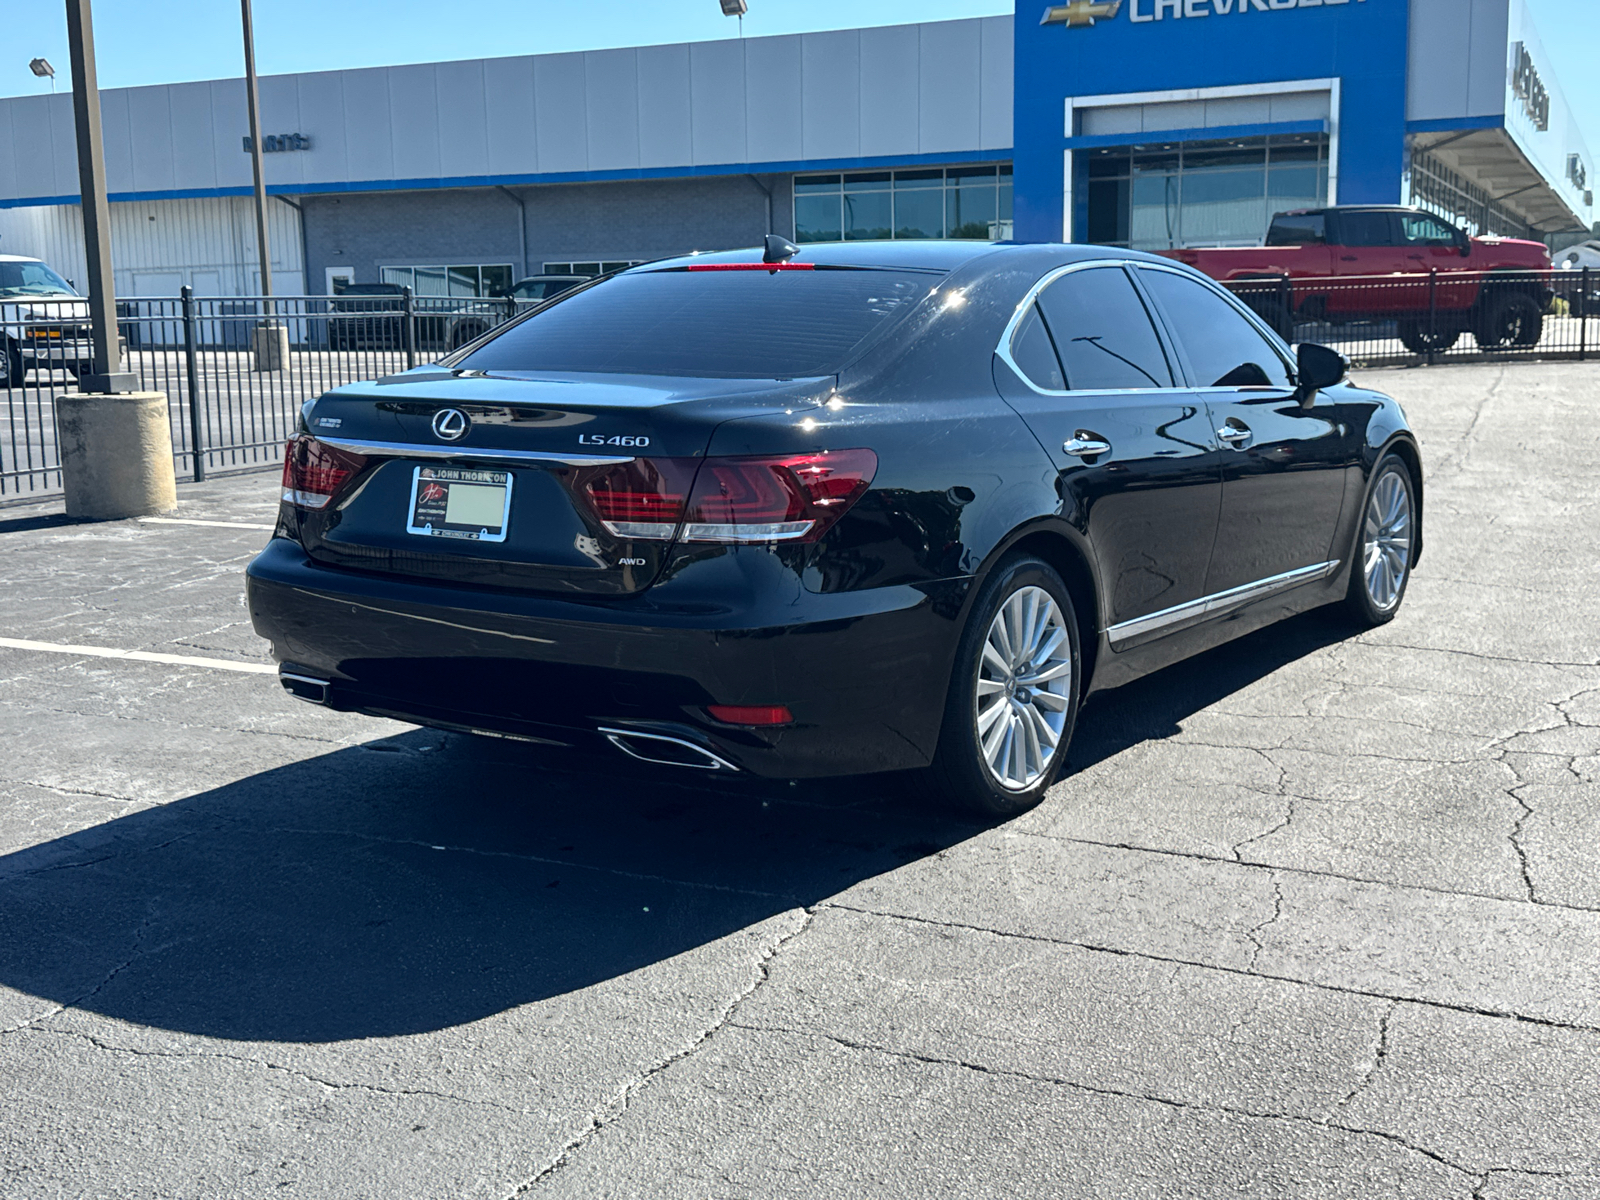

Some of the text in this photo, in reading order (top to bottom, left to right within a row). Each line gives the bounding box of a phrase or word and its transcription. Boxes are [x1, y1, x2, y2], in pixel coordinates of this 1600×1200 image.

[242, 132, 305, 153] PRTS
[436, 470, 459, 480] JOHN
[618, 557, 646, 566] AWD
